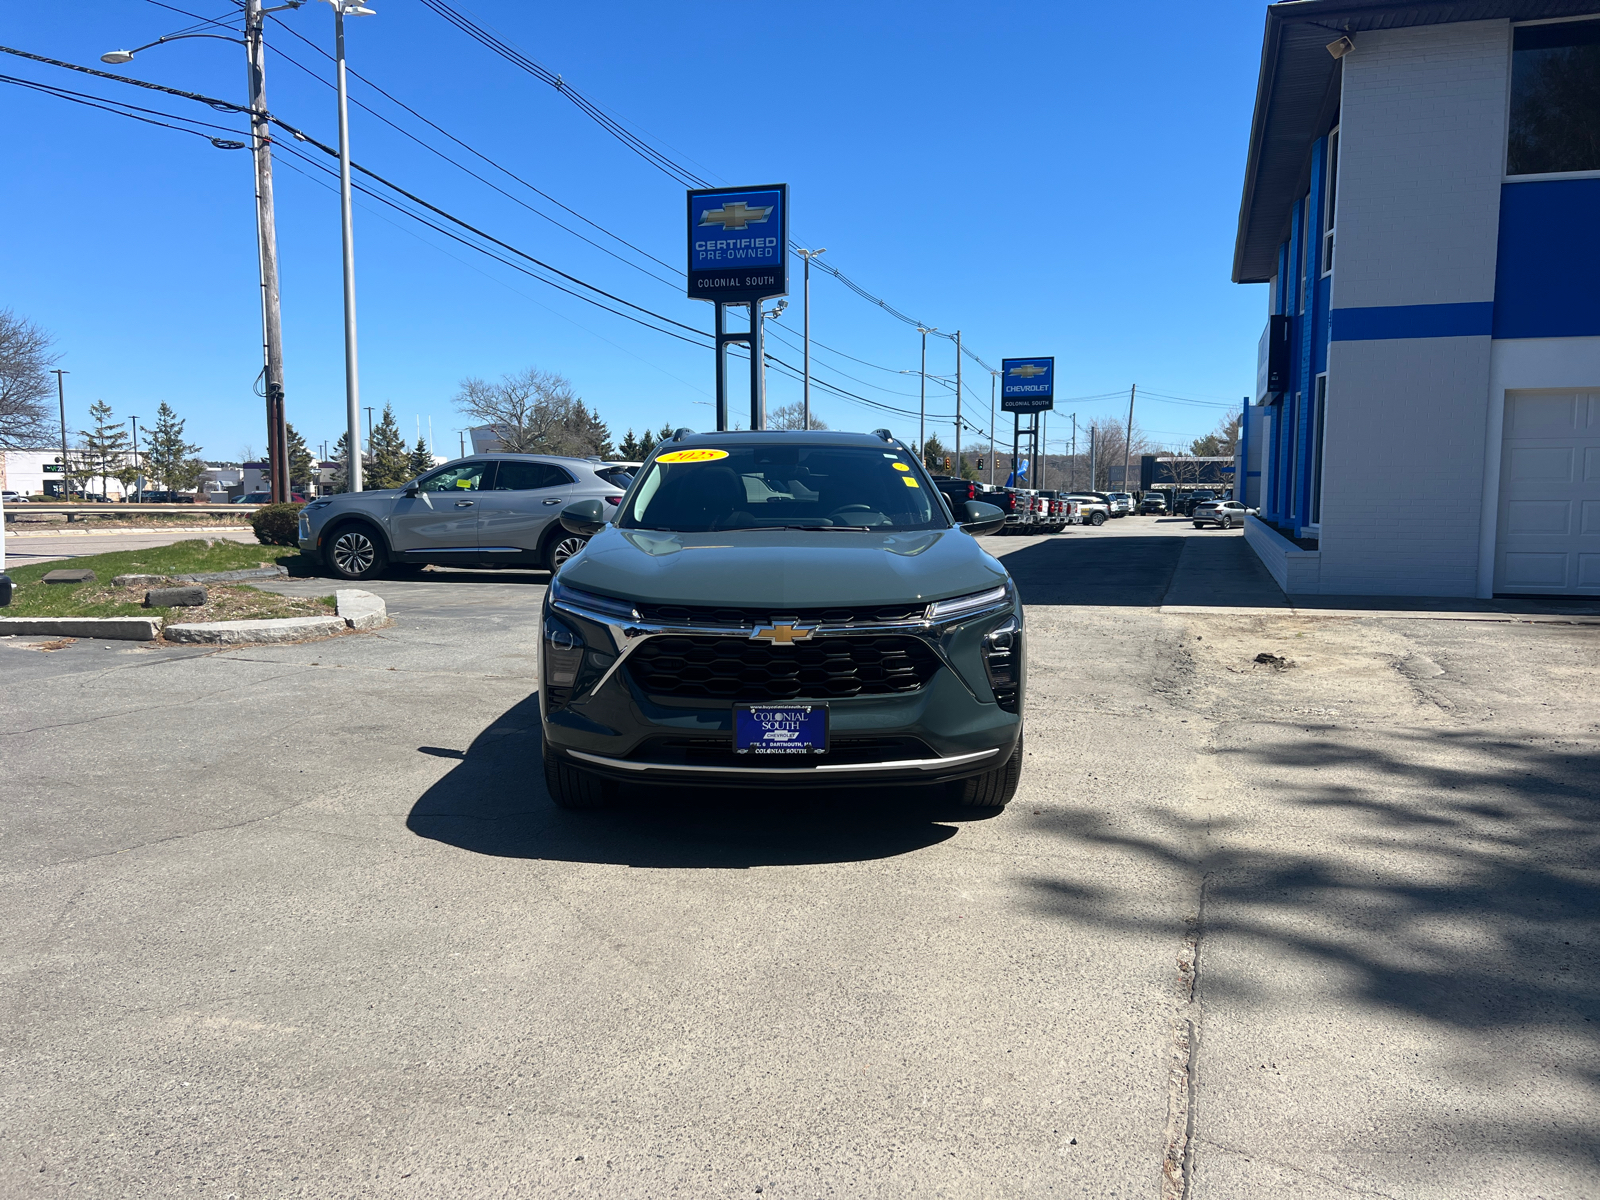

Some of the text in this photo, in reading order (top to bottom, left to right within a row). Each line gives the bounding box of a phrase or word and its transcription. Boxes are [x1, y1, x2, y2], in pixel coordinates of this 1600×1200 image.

[696, 237, 776, 250] CERTIFIED
[699, 248, 772, 260] PRE-OWNED
[698, 276, 774, 287] COLONIAL SOUTH
[666, 451, 719, 462] 2025
[754, 712, 808, 721] COLONIAL
[762, 722, 799, 730] SOUTH
